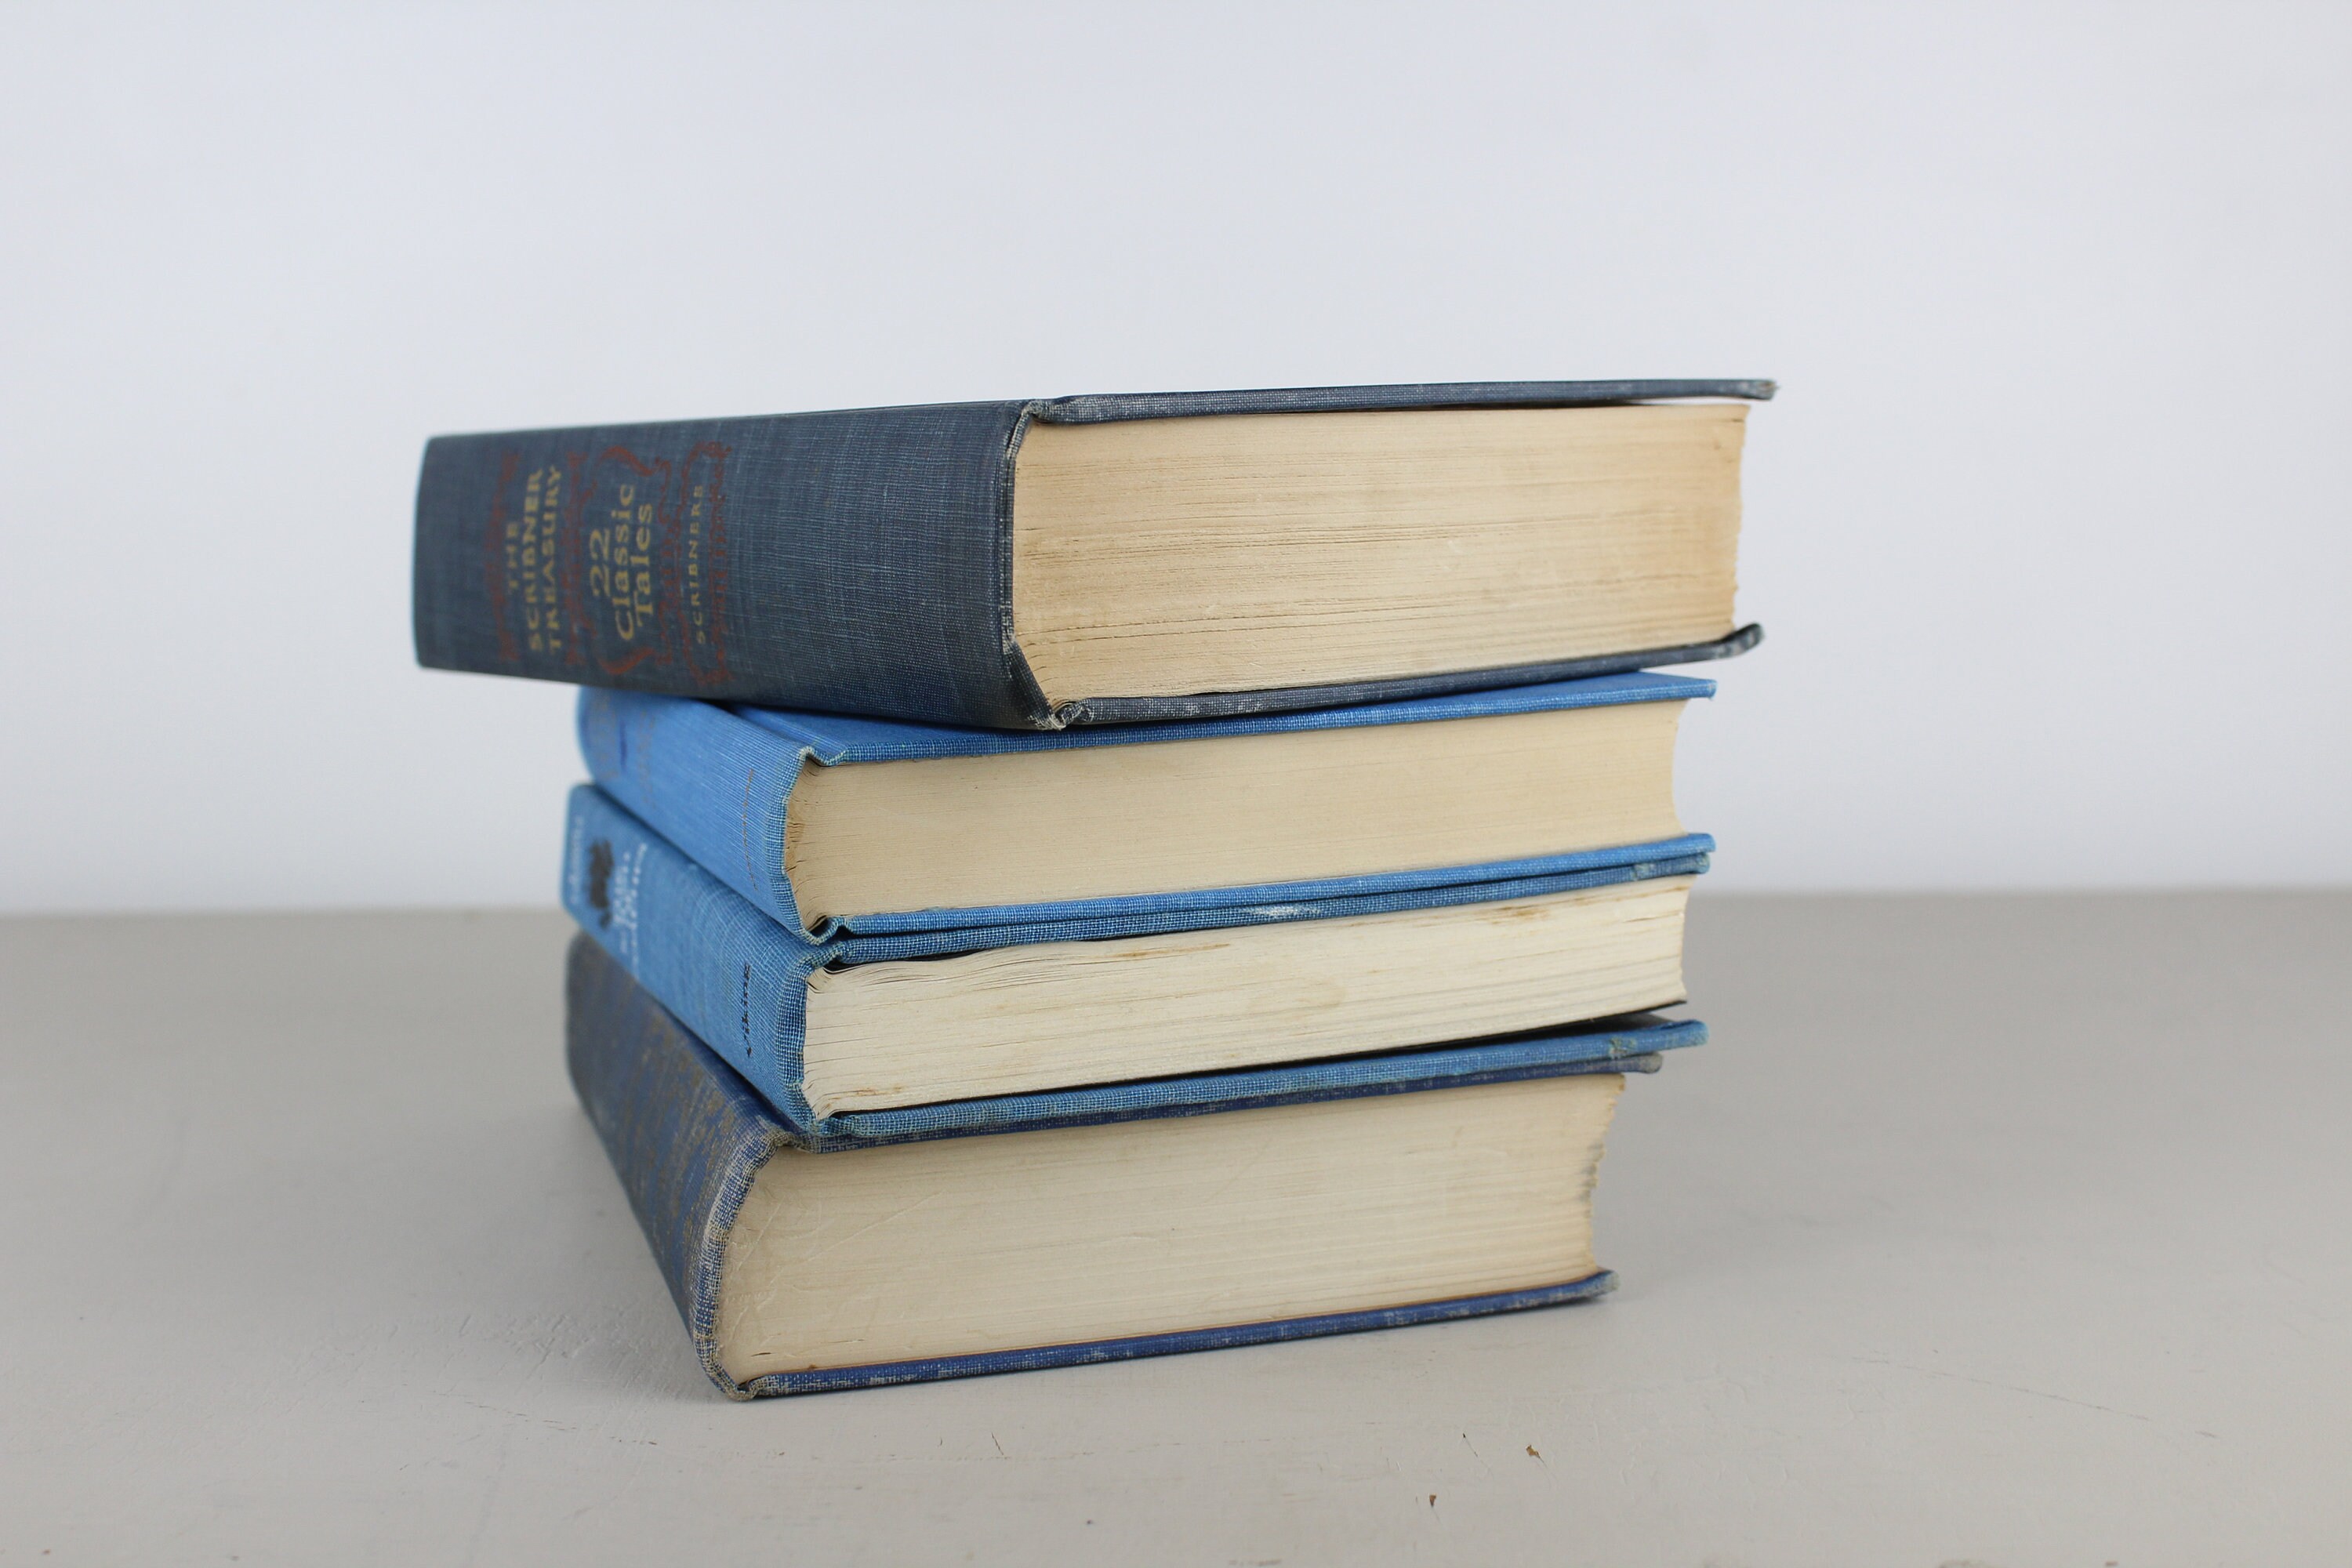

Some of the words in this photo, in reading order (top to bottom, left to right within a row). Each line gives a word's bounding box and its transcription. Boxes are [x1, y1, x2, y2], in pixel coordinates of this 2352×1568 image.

[506, 521, 519, 594] THE
[522, 469, 543, 652] SCRIBNER
[542, 466, 562, 654] TREASURY
[590, 528, 610, 597] 22
[612, 484, 634, 640] Classic
[630, 503, 653, 627] Tales
[688, 485, 706, 644] SCRIBNERS
